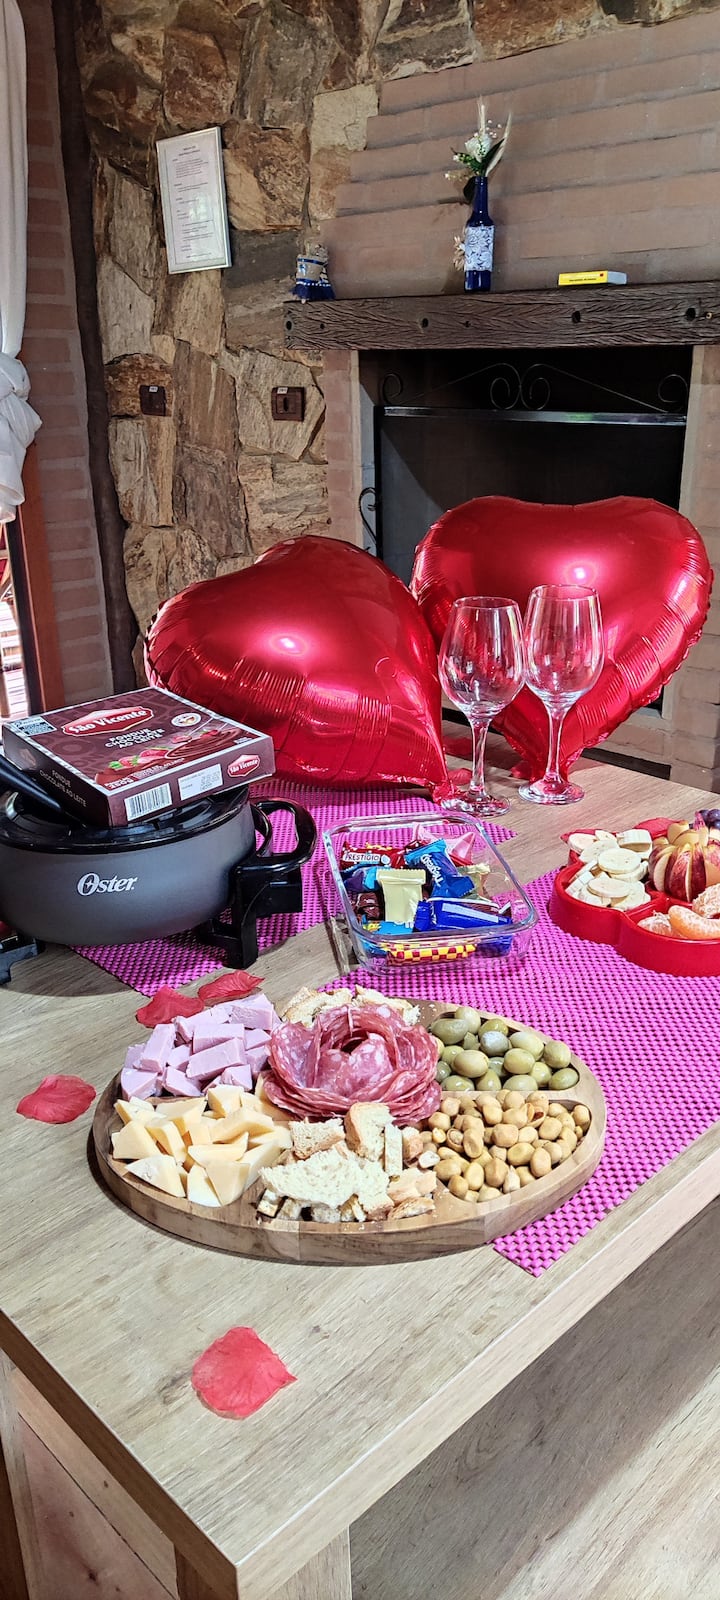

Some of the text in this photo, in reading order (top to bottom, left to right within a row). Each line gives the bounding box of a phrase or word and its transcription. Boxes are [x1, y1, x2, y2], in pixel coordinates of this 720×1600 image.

[69, 710, 147, 733] São Vicente
[105, 729, 165, 747] CHOCOLATE
[109, 728, 151, 742] FONDUE
